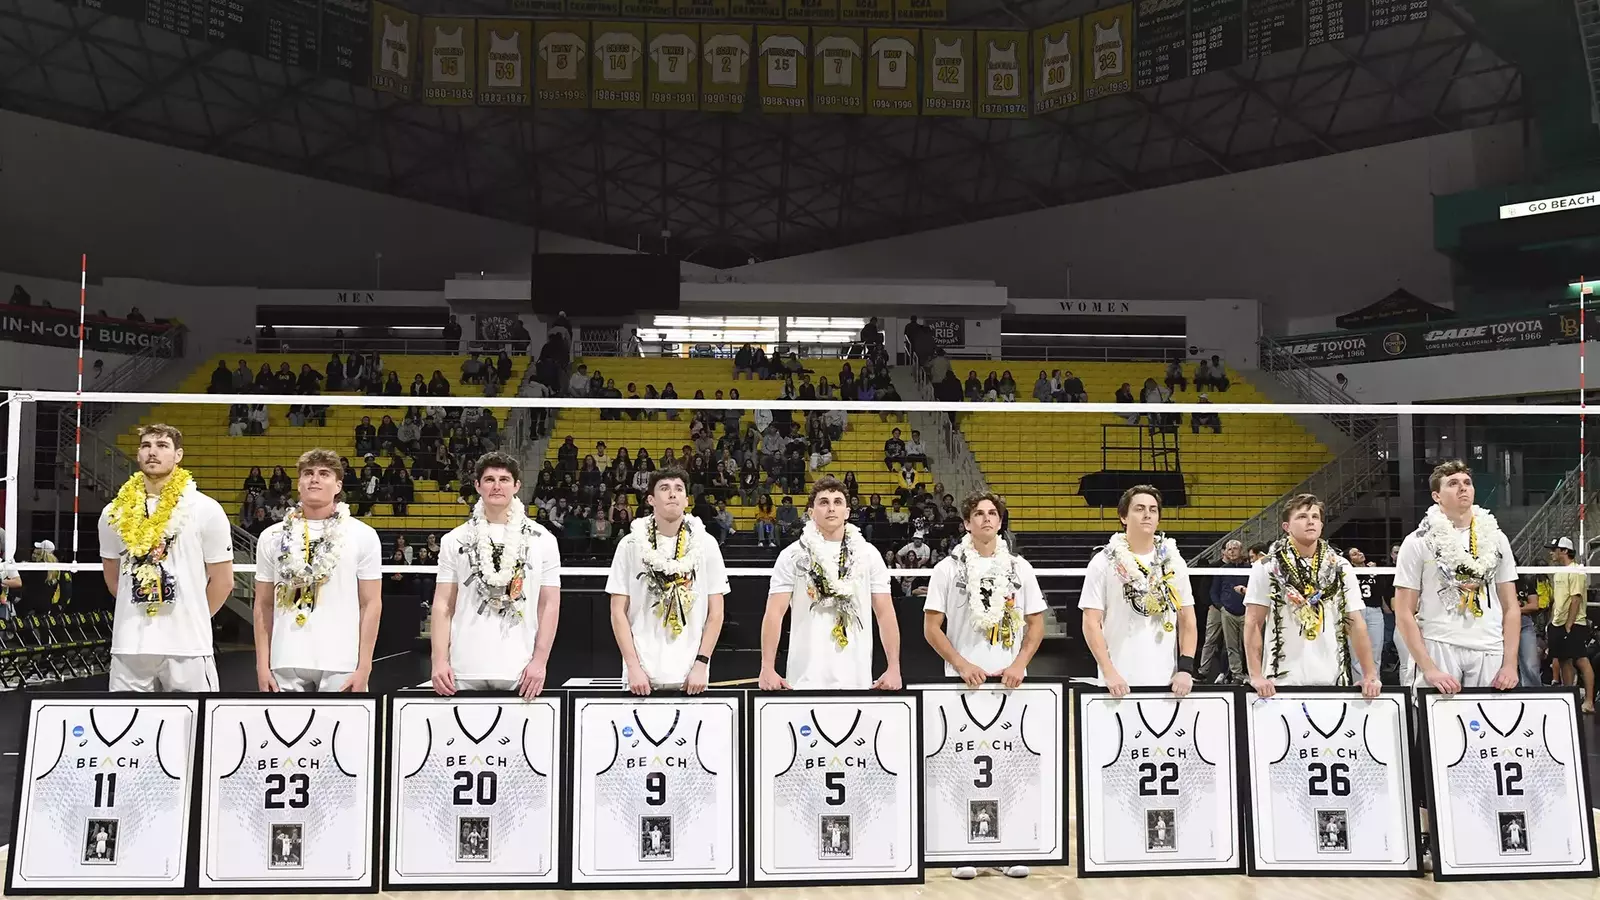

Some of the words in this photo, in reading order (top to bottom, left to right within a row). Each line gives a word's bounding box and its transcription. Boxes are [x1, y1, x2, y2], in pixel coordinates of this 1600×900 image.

[1410, 0, 1428, 10] 2022
[1410, 10, 1428, 20] 2023
[609, 54, 626, 70] 14
[667, 56, 678, 72] 7
[721, 57, 731, 72] 2
[774, 58, 790, 71] 15
[834, 58, 843, 74] 7
[937, 66, 959, 83] 42
[993, 73, 1014, 90] 20
[1529, 202, 1547, 212] GO
[1551, 195, 1595, 209] BEACH
[336, 293, 376, 303] MEN
[1059, 301, 1130, 313] WOMEN
[2, 316, 92, 340] IN-N-OUT
[481, 316, 514, 327] NAPLES
[928, 321, 960, 331] NAPLES
[935, 328, 954, 338] RIB
[1424, 325, 1488, 342] CABE
[1490, 320, 1543, 335] TOYOTA
[1321, 338, 1366, 352] TOYOTA
[1462, 339, 1493, 347] CALIFORNIA
[1520, 332, 1542, 341] 1966
[1327, 352, 1344, 360] Since
[1347, 350, 1365, 358] 1966
[956, 741, 1012, 752] BEACH
[1132, 748, 1186, 759] BEACH
[1300, 748, 1357, 759] BEACH
[1480, 747, 1533, 759] BEACH
[77, 757, 138, 768] BEACH
[258, 758, 319, 770] BEACH
[447, 756, 506, 767] BEACH
[627, 757, 686, 768] BEACH
[806, 757, 865, 769] BEACH
[974, 756, 992, 788] 3
[1494, 763, 1523, 795] 12
[1139, 763, 1179, 796] 22
[1308, 763, 1350, 796] 26
[95, 773, 116, 807] 11
[265, 774, 309, 808] 23
[453, 771, 497, 805] 20
[647, 772, 665, 805] 9
[826, 772, 845, 805] 5
